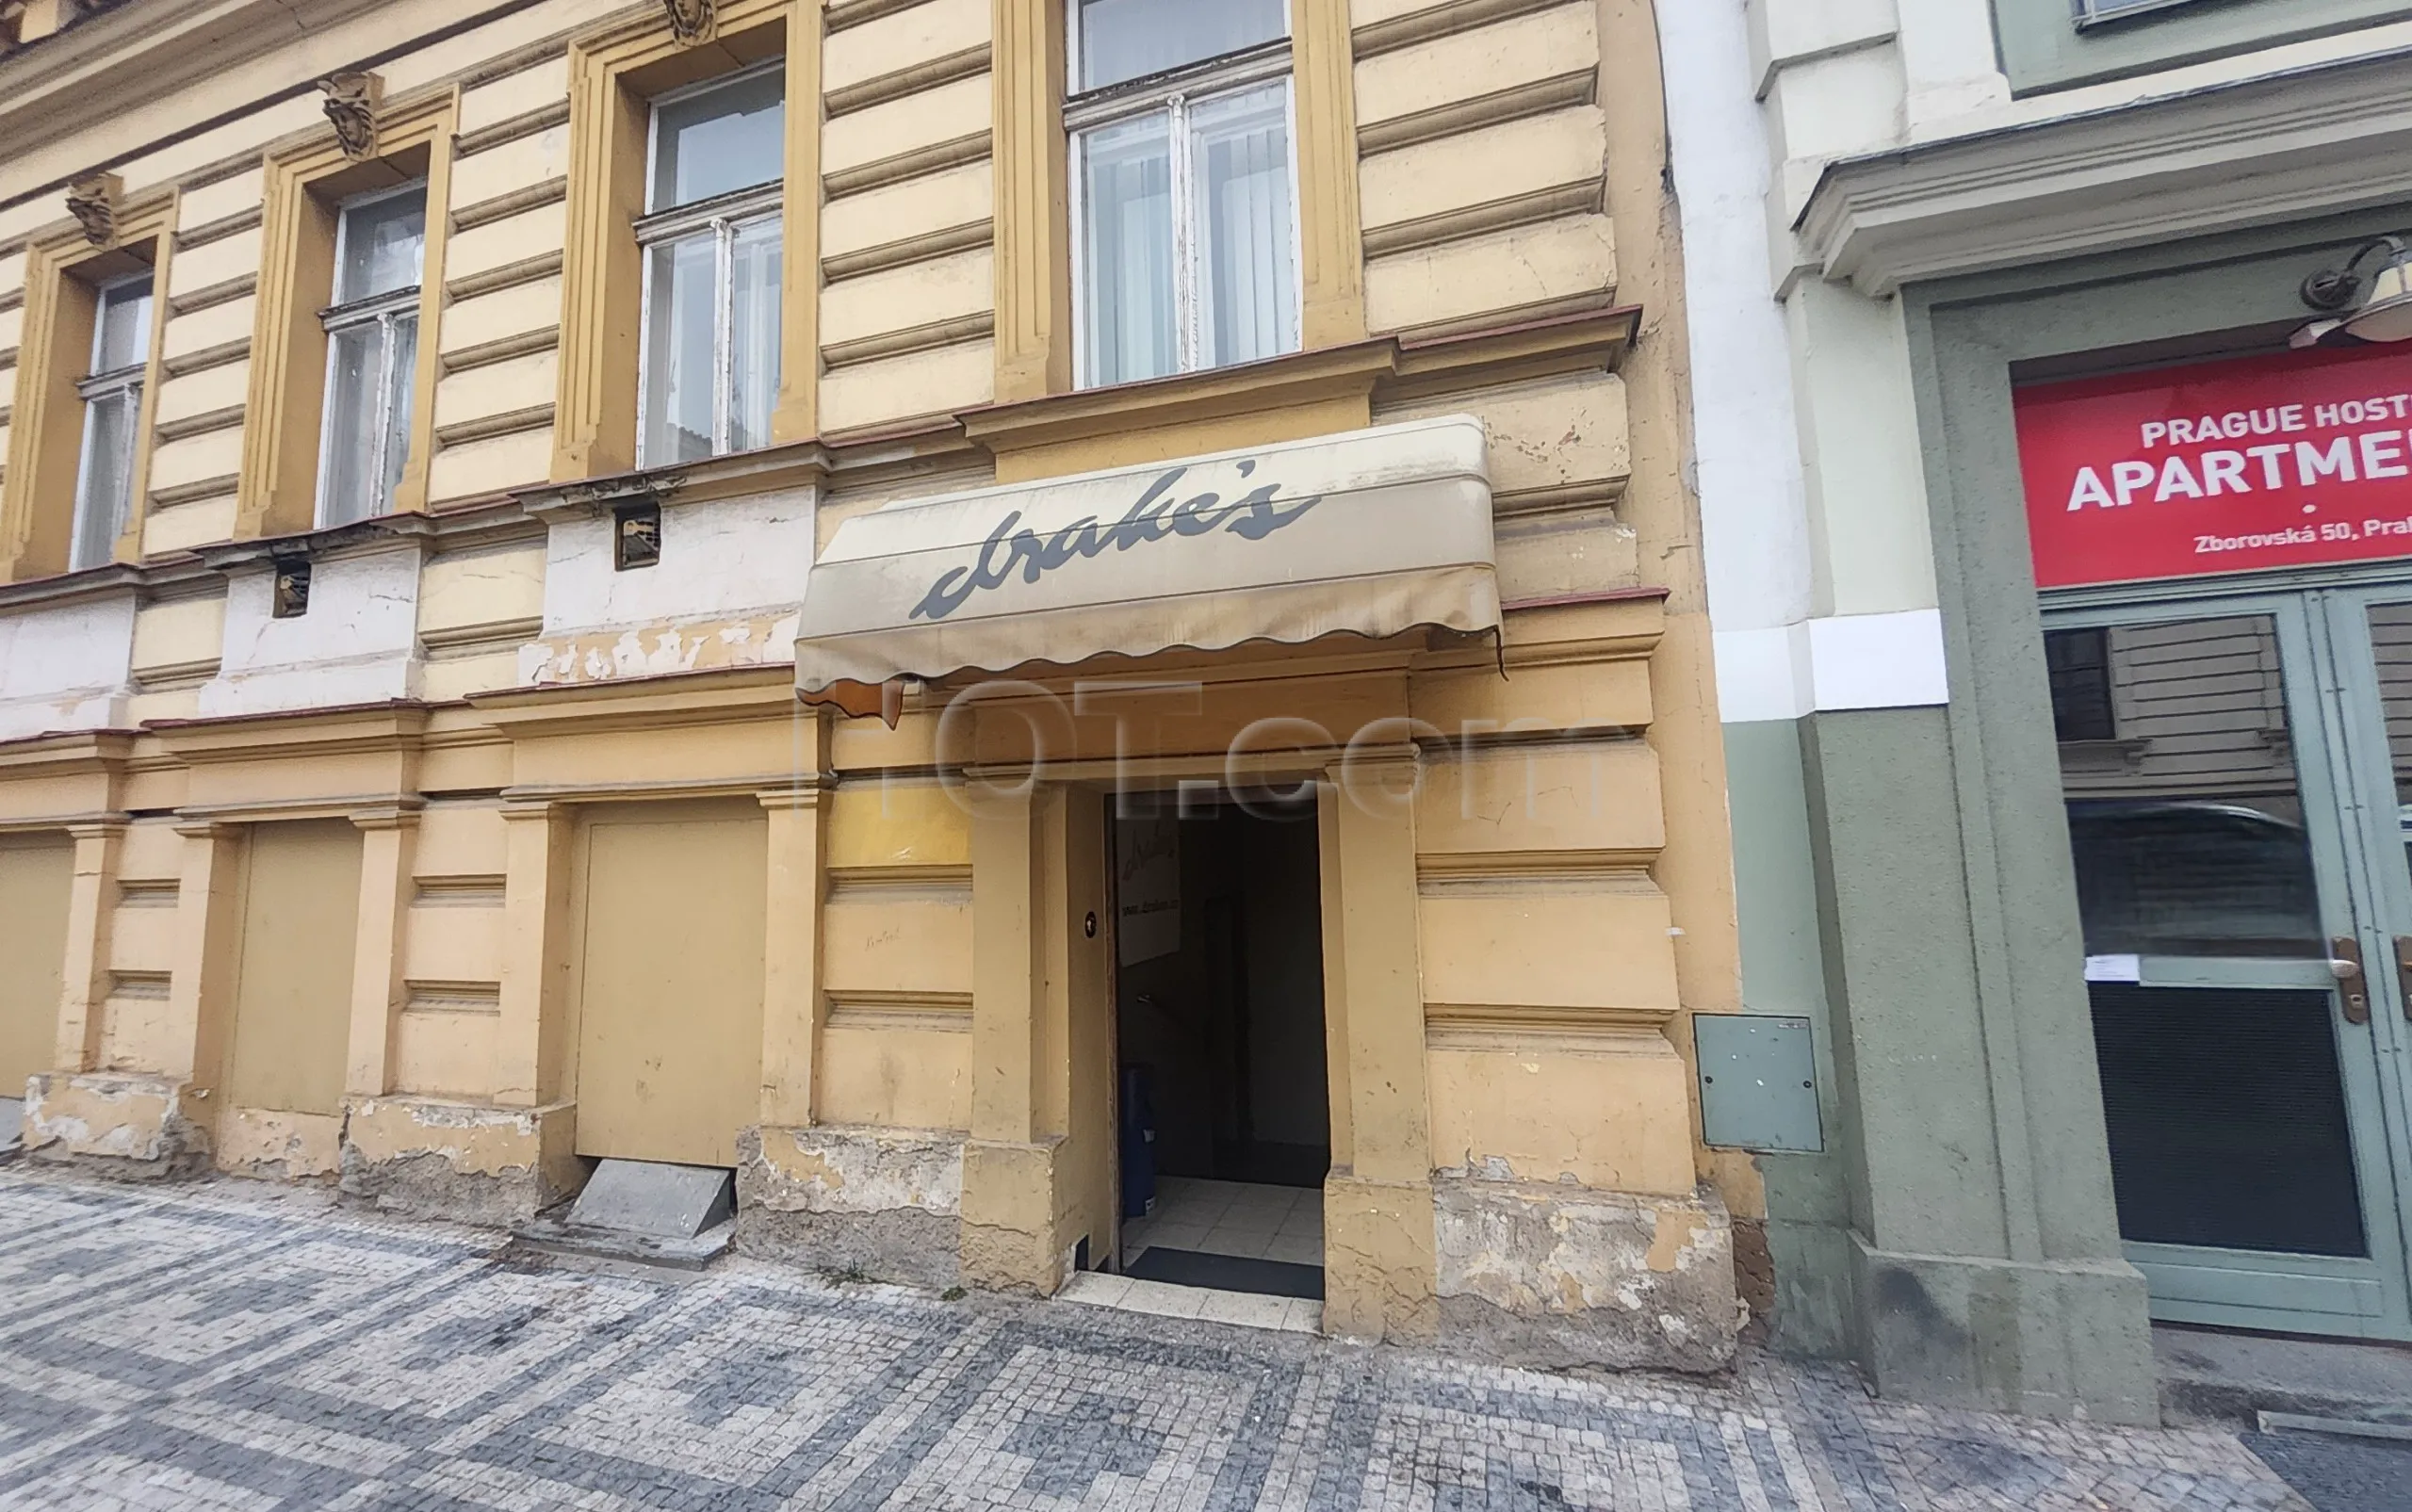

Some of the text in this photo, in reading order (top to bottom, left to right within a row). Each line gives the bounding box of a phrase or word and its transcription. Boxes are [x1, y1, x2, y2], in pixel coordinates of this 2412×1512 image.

[2141, 394, 2412, 448] PRAGUE HOST
[2067, 429, 2412, 511] APARTME
[909, 459, 1323, 620] drake's
[2193, 525, 2316, 553] Zborovská
[2321, 522, 2359, 542] 50,
